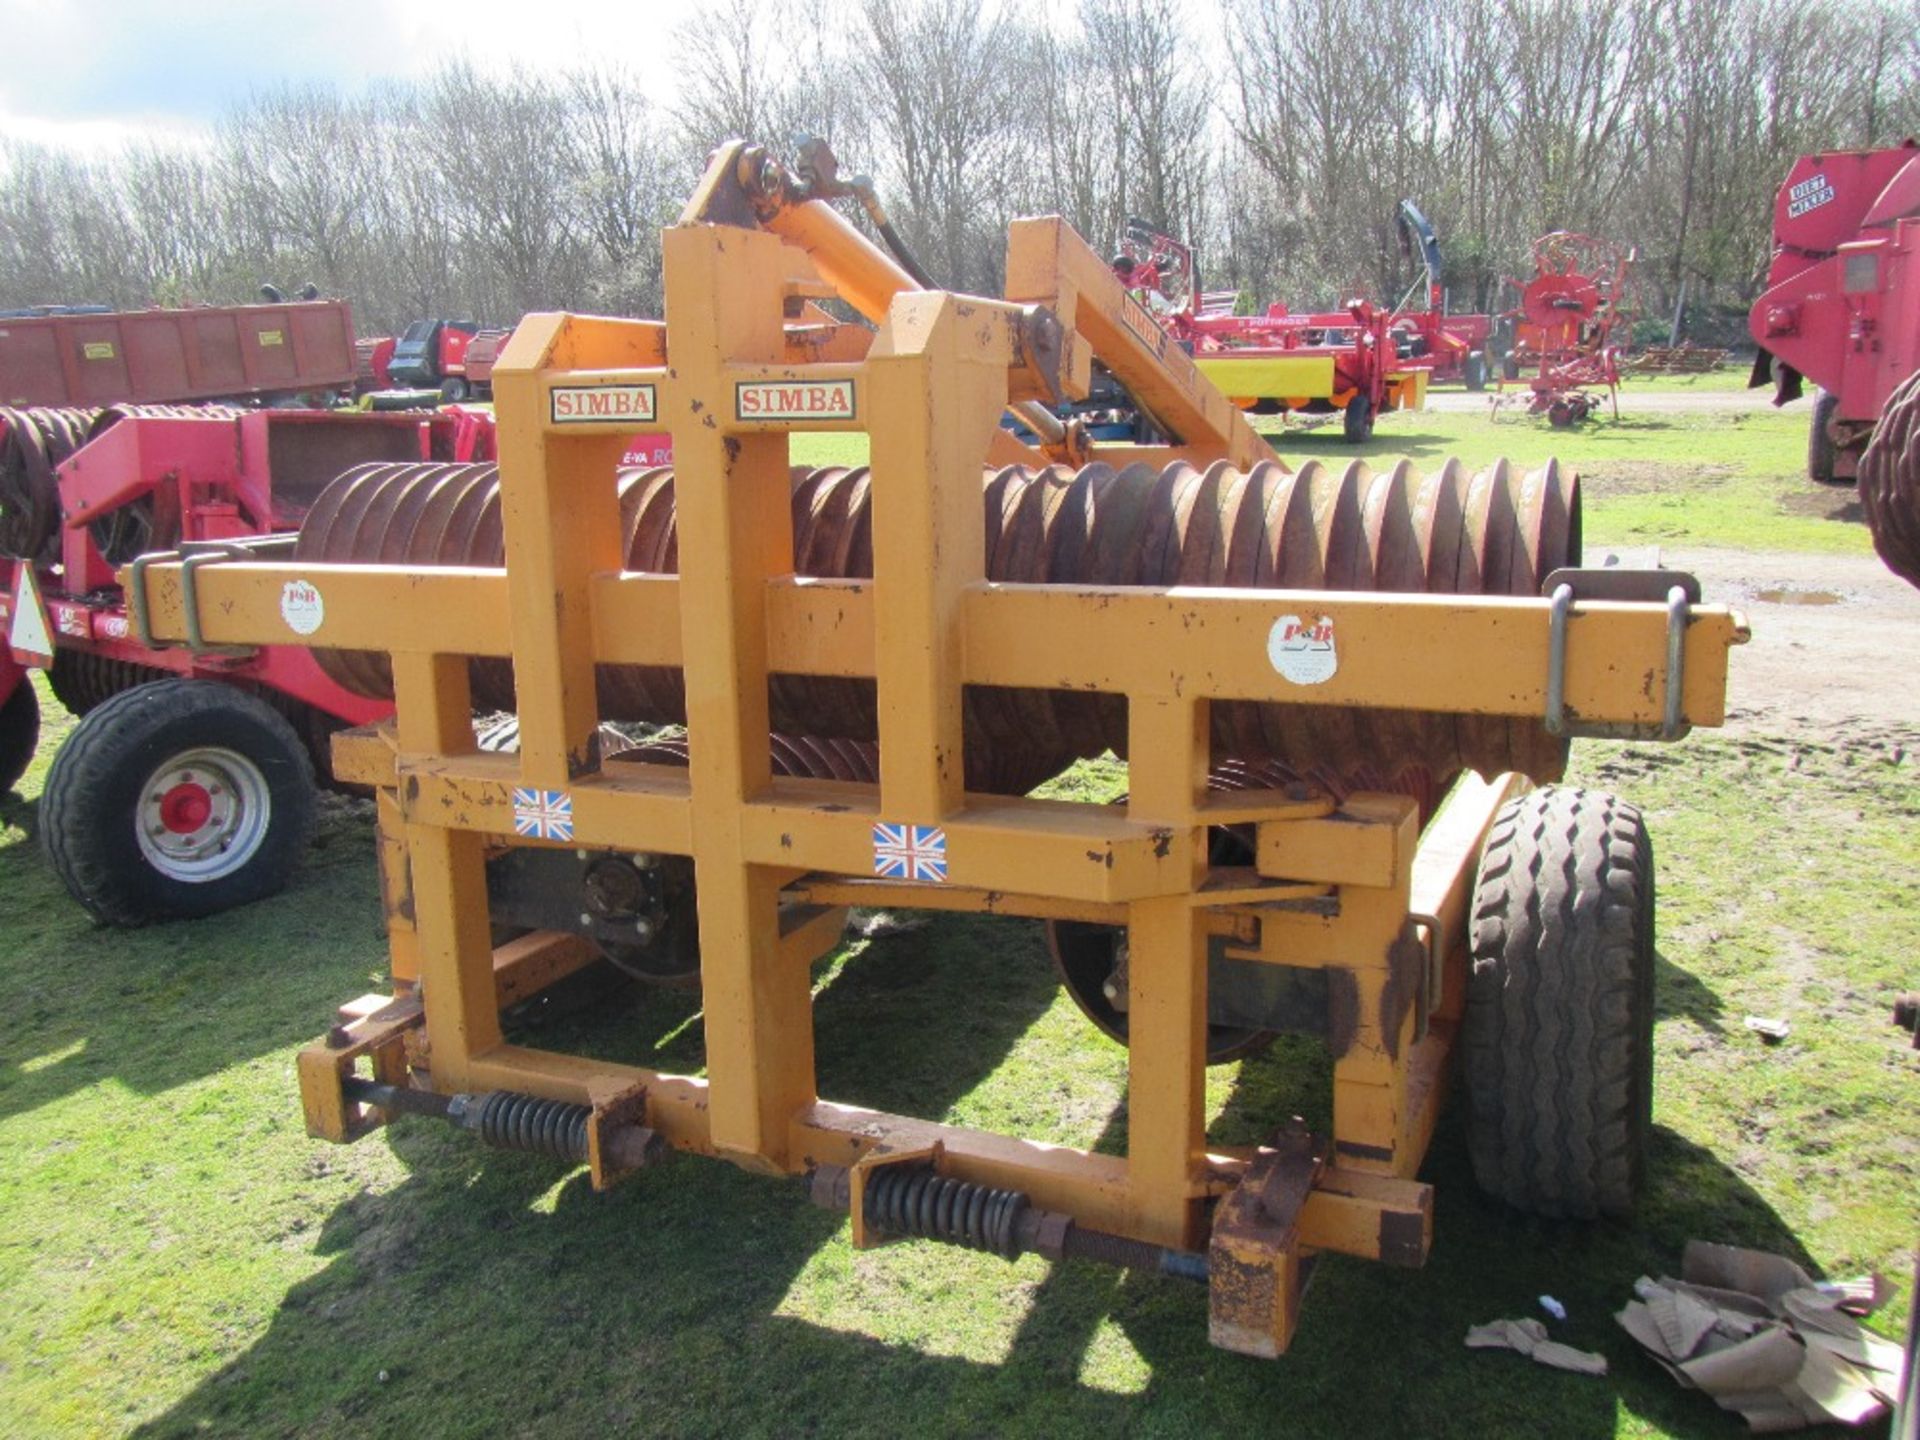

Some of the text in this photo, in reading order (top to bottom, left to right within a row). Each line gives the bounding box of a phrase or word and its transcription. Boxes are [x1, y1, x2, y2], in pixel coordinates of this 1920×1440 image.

[1793, 175, 1824, 198] DIET
[1790, 188, 1833, 214] MIXER
[556, 391, 652, 416] SIMBA
[742, 387, 849, 413] SIMBA
